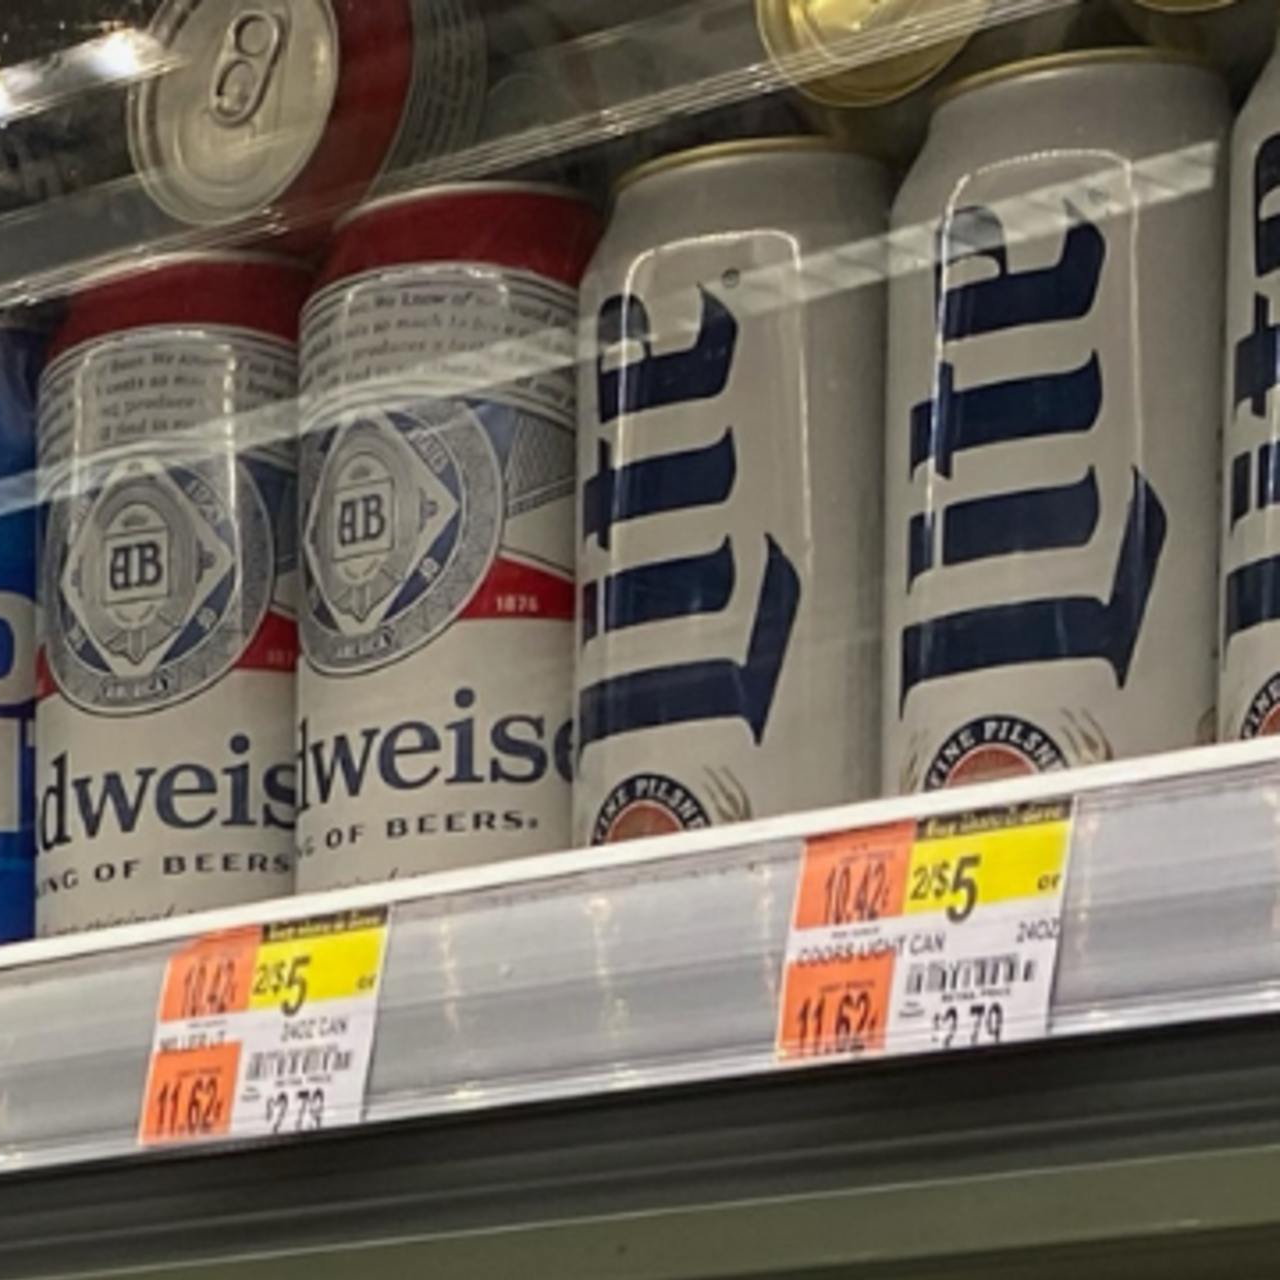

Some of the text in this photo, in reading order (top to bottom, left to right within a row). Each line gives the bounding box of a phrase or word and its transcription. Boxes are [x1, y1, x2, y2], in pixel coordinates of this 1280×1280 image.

[899, 197, 1168, 720] Lite
[325, 822, 366, 847] OF
[93, 859, 139, 881] OF
[909, 854, 981, 923] 2/$5
[796, 941, 854, 968] COORS
[908, 931, 946, 957] CAN
